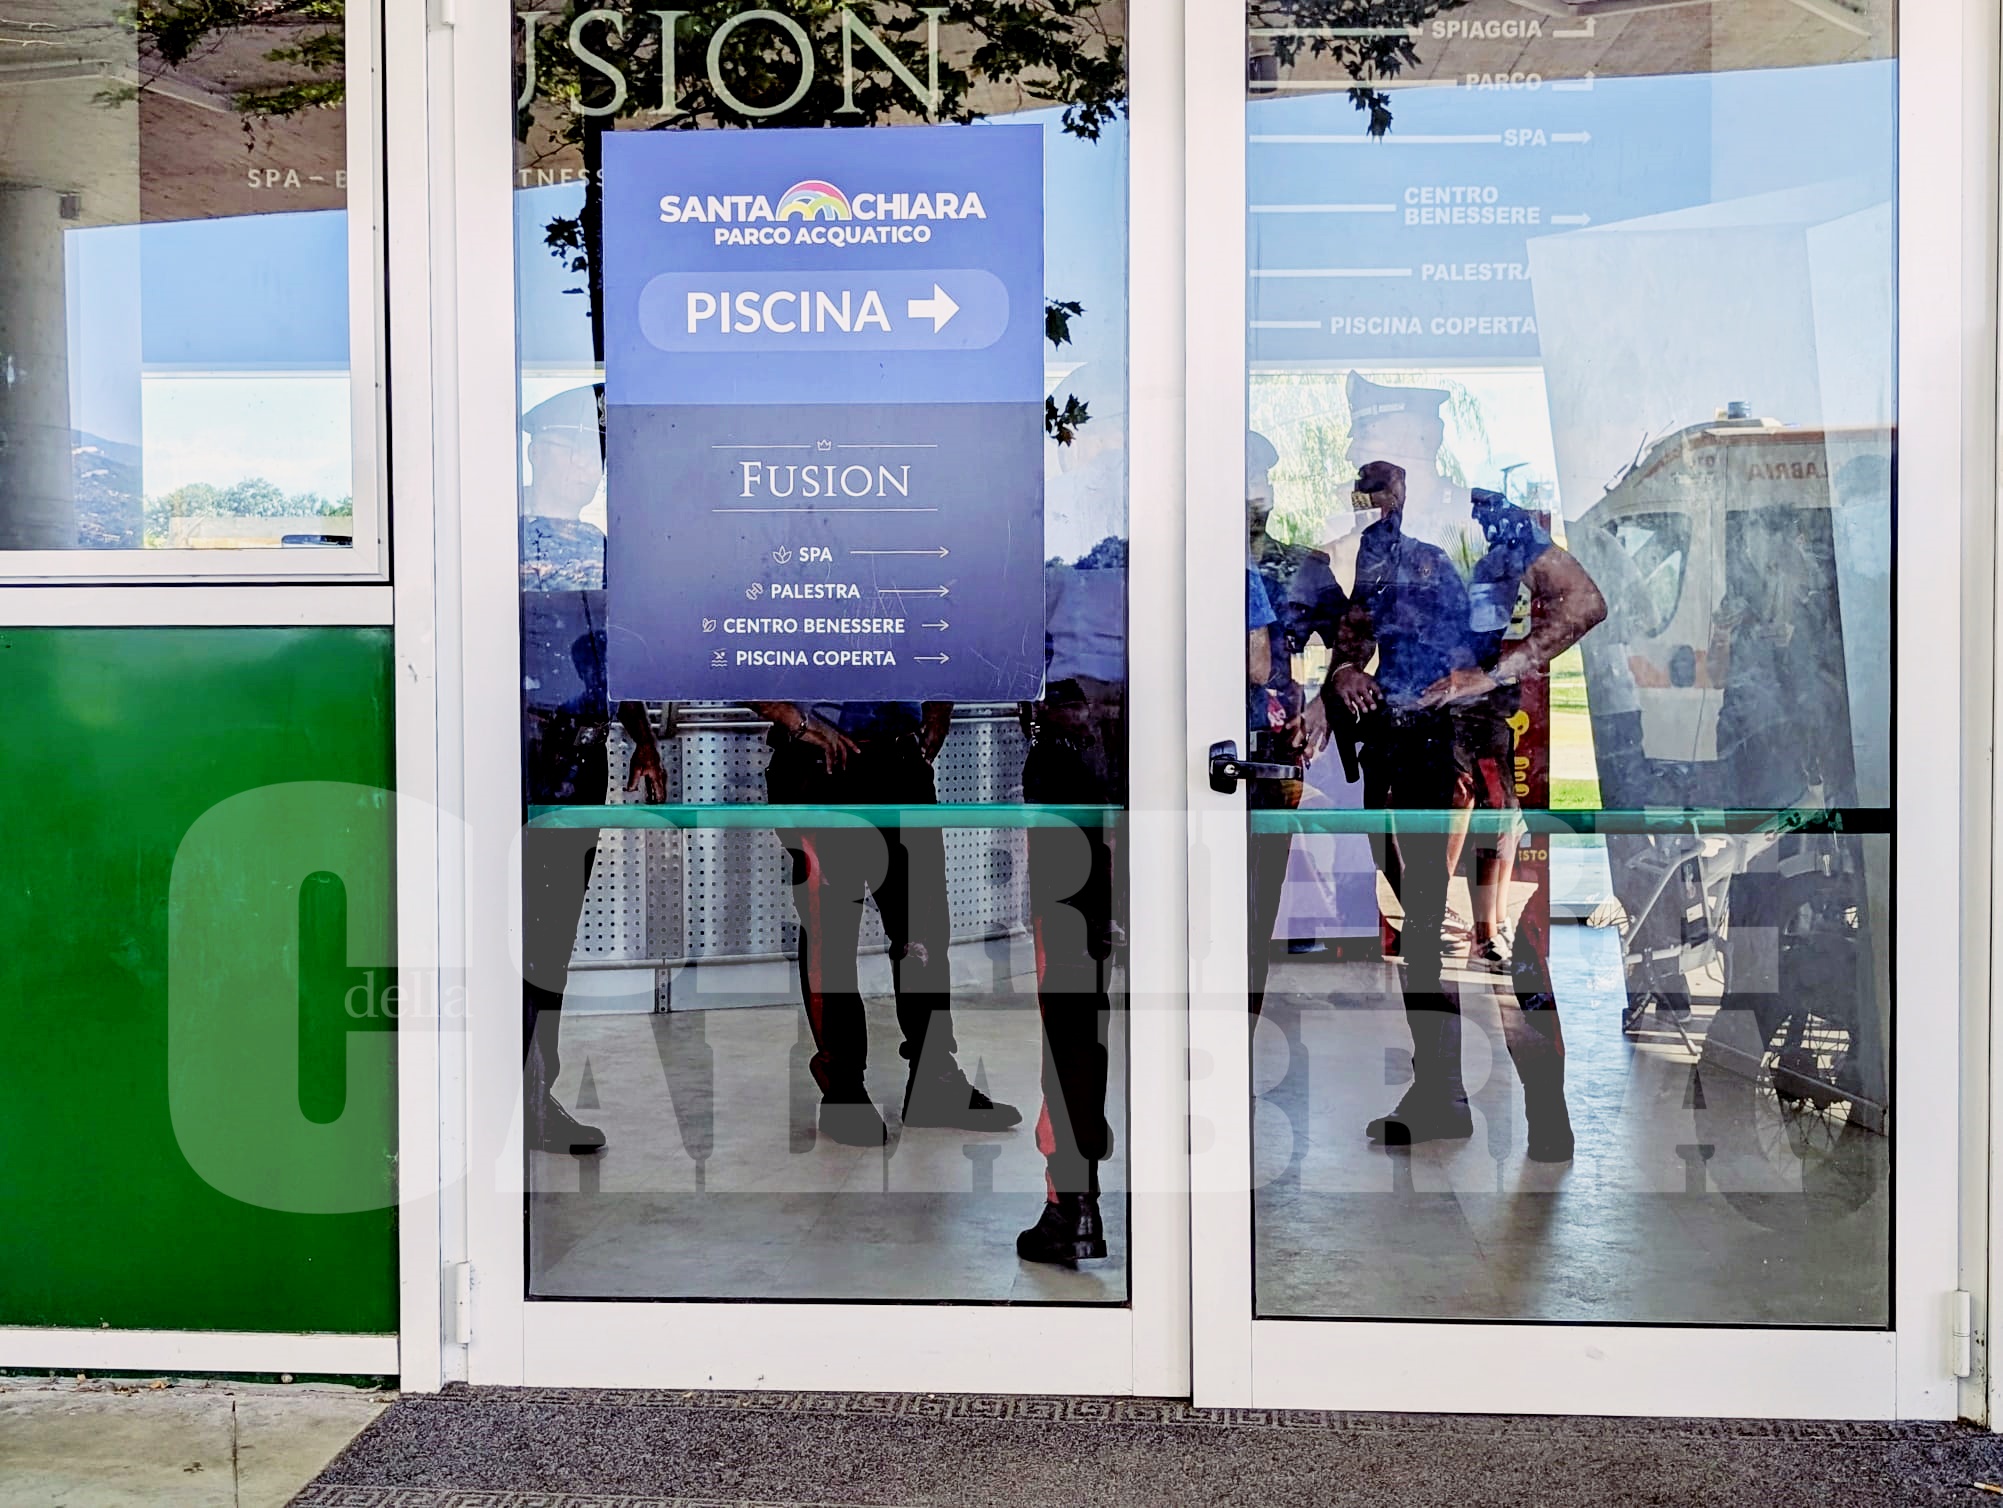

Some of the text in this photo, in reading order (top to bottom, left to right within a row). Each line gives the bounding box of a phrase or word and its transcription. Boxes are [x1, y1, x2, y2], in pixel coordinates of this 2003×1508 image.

[1432, 20, 1542, 39] SPIAGGIA
[1466, 72, 1542, 91] PARCO
[1504, 129, 1547, 147] SPA
[248, 168, 300, 189] SPA
[1404, 186, 1498, 204] CENTRO
[659, 192, 987, 223] SANTA CHIARA
[1404, 207, 1541, 225] BENESSERE
[715, 225, 932, 247] PARCO ACQUATICO
[686, 290, 892, 334] PISCINA
[1331, 316, 1537, 335] PISCINA COPERTA
[739, 461, 911, 498] FUSION
[799, 546, 833, 563] SPA
[771, 583, 860, 600] PALESTRA
[723, 618, 905, 634] CENTRO BENESSERE
[736, 650, 896, 666] PISCINA COPERTA
